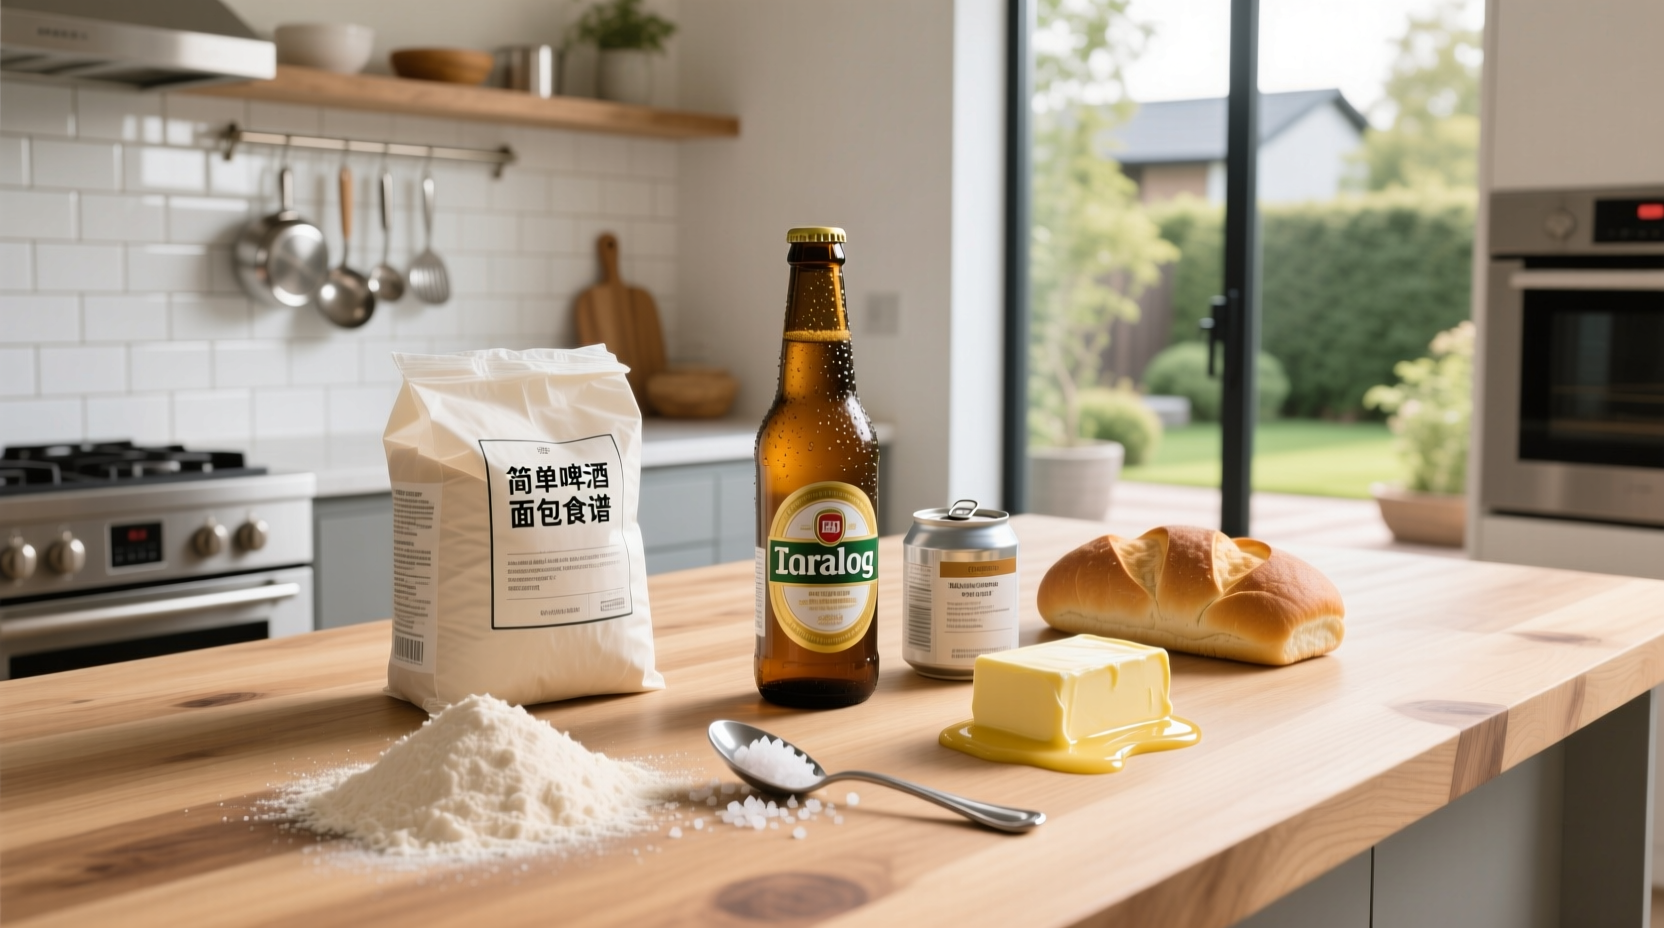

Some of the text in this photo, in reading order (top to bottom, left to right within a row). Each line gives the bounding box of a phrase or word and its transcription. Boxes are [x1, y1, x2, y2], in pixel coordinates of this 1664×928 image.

[506, 462, 609, 495] 简单啤酒
[509, 493, 611, 528] 面包食谱
